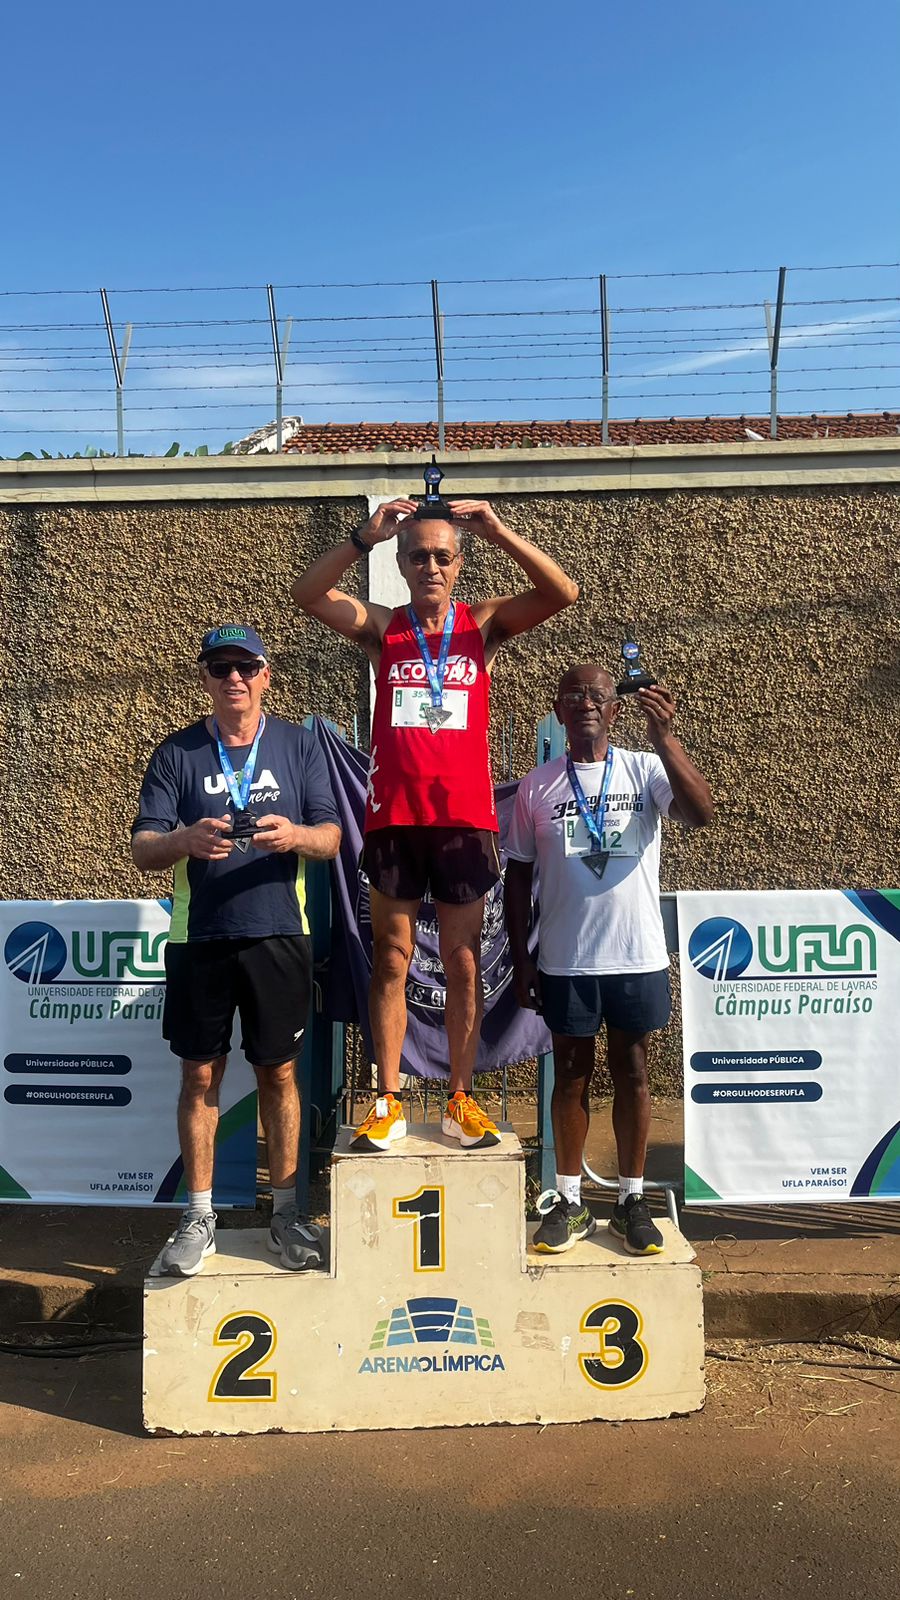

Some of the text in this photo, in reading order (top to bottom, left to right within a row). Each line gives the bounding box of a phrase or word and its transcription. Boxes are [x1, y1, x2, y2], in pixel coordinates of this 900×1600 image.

[758, 924, 876, 973] UFLA
[713, 980, 878, 993] UNIVERSIDADE FEDERAL DE LAVRAS
[28, 987, 93, 997] UNIVERSIDADE
[96, 987, 135, 997] FEDERAL
[138, 987, 150, 997] DE
[29, 996, 164, 1025] Câmpus Paraí
[715, 991, 873, 1021] Câmpus Paraíso
[25, 1059, 115, 1068] Universidade PÚBLICA
[712, 1055, 805, 1065] Universidade PÚBLICA
[25, 1091, 114, 1100] #ORGULHODESERUFLA
[712, 1089, 805, 1097] #ORGULHODESERUFLA
[117, 1172, 154, 1180] VEM SER
[810, 1167, 847, 1175] VEM SER
[90, 1181, 153, 1191] UFLA PARAÍSO!
[782, 1177, 847, 1187] UFLA PARAÍSO!
[393, 1185, 445, 1273] 1
[578, 1298, 650, 1391] 3
[207, 1310, 277, 1402] 2
